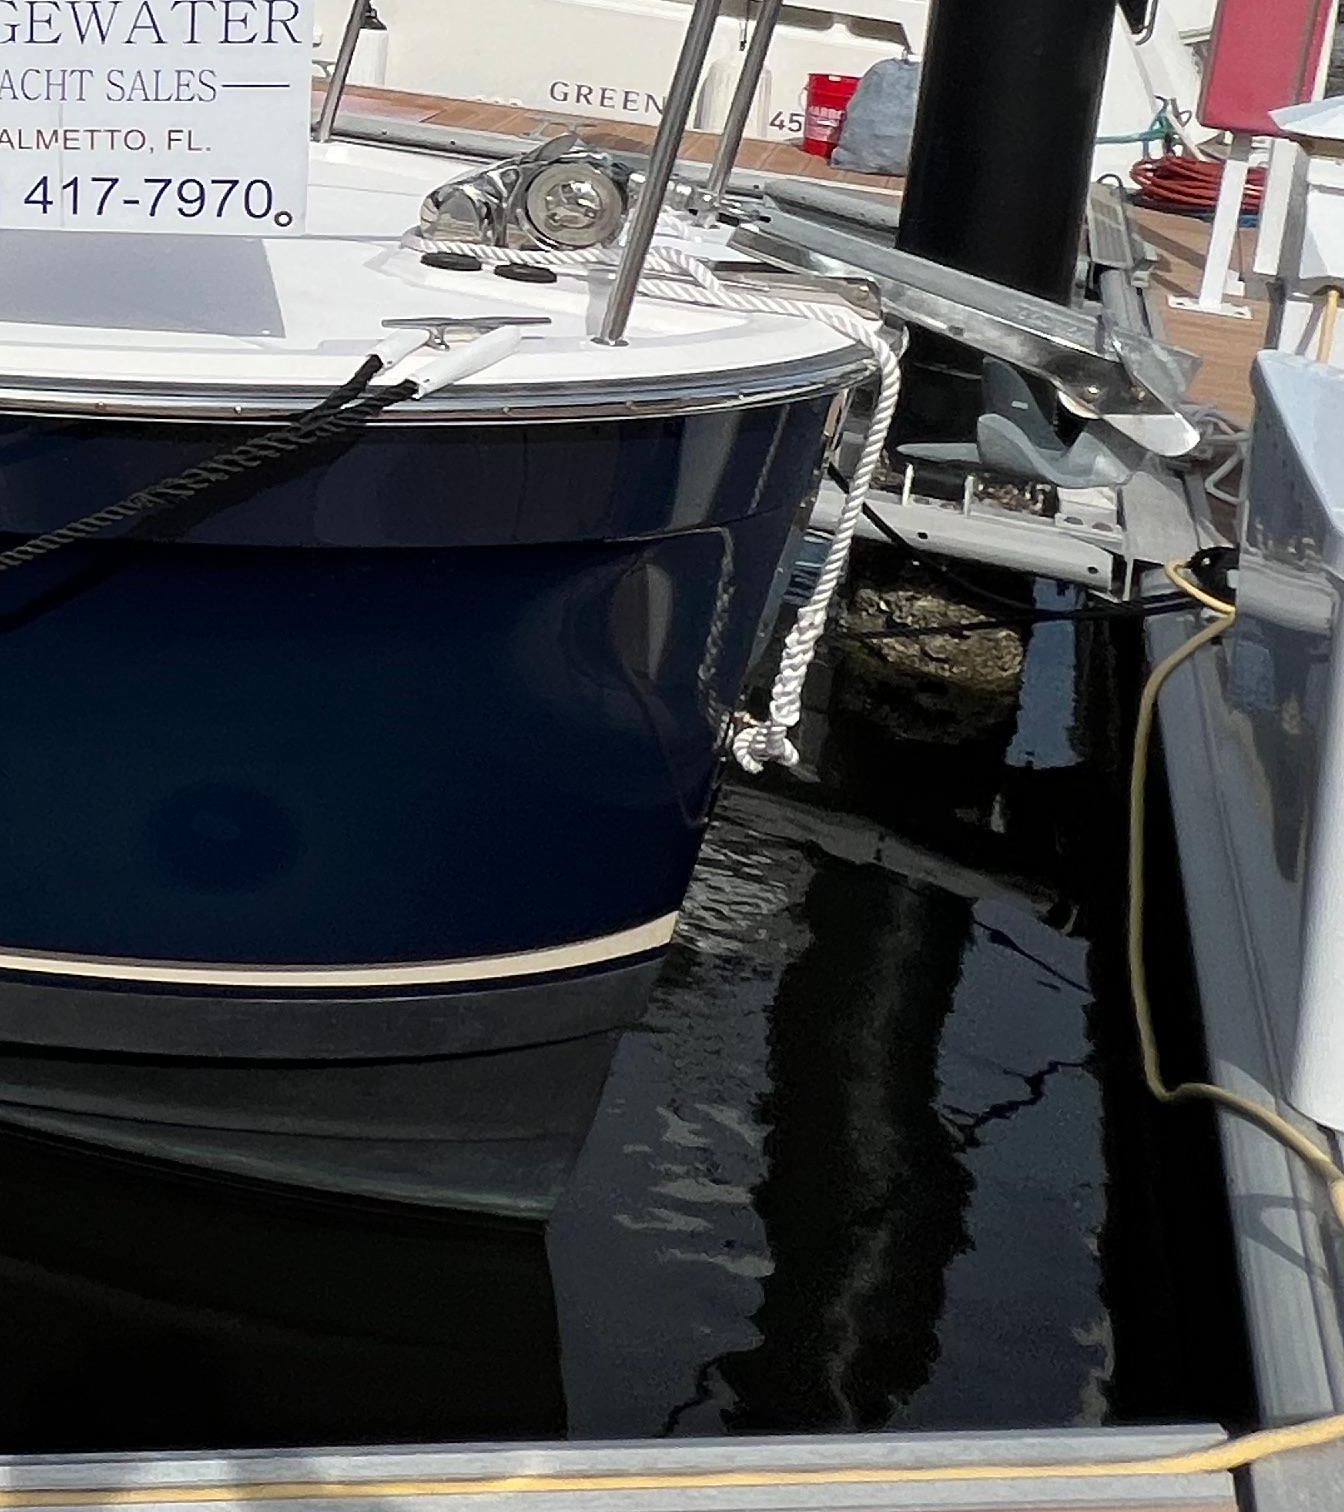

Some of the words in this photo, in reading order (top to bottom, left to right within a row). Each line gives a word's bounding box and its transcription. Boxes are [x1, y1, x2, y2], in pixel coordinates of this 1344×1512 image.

[106, 69, 218, 102] SALES
[167, 129, 212, 152] FL.
[24, 175, 274, 219] 417-7970
